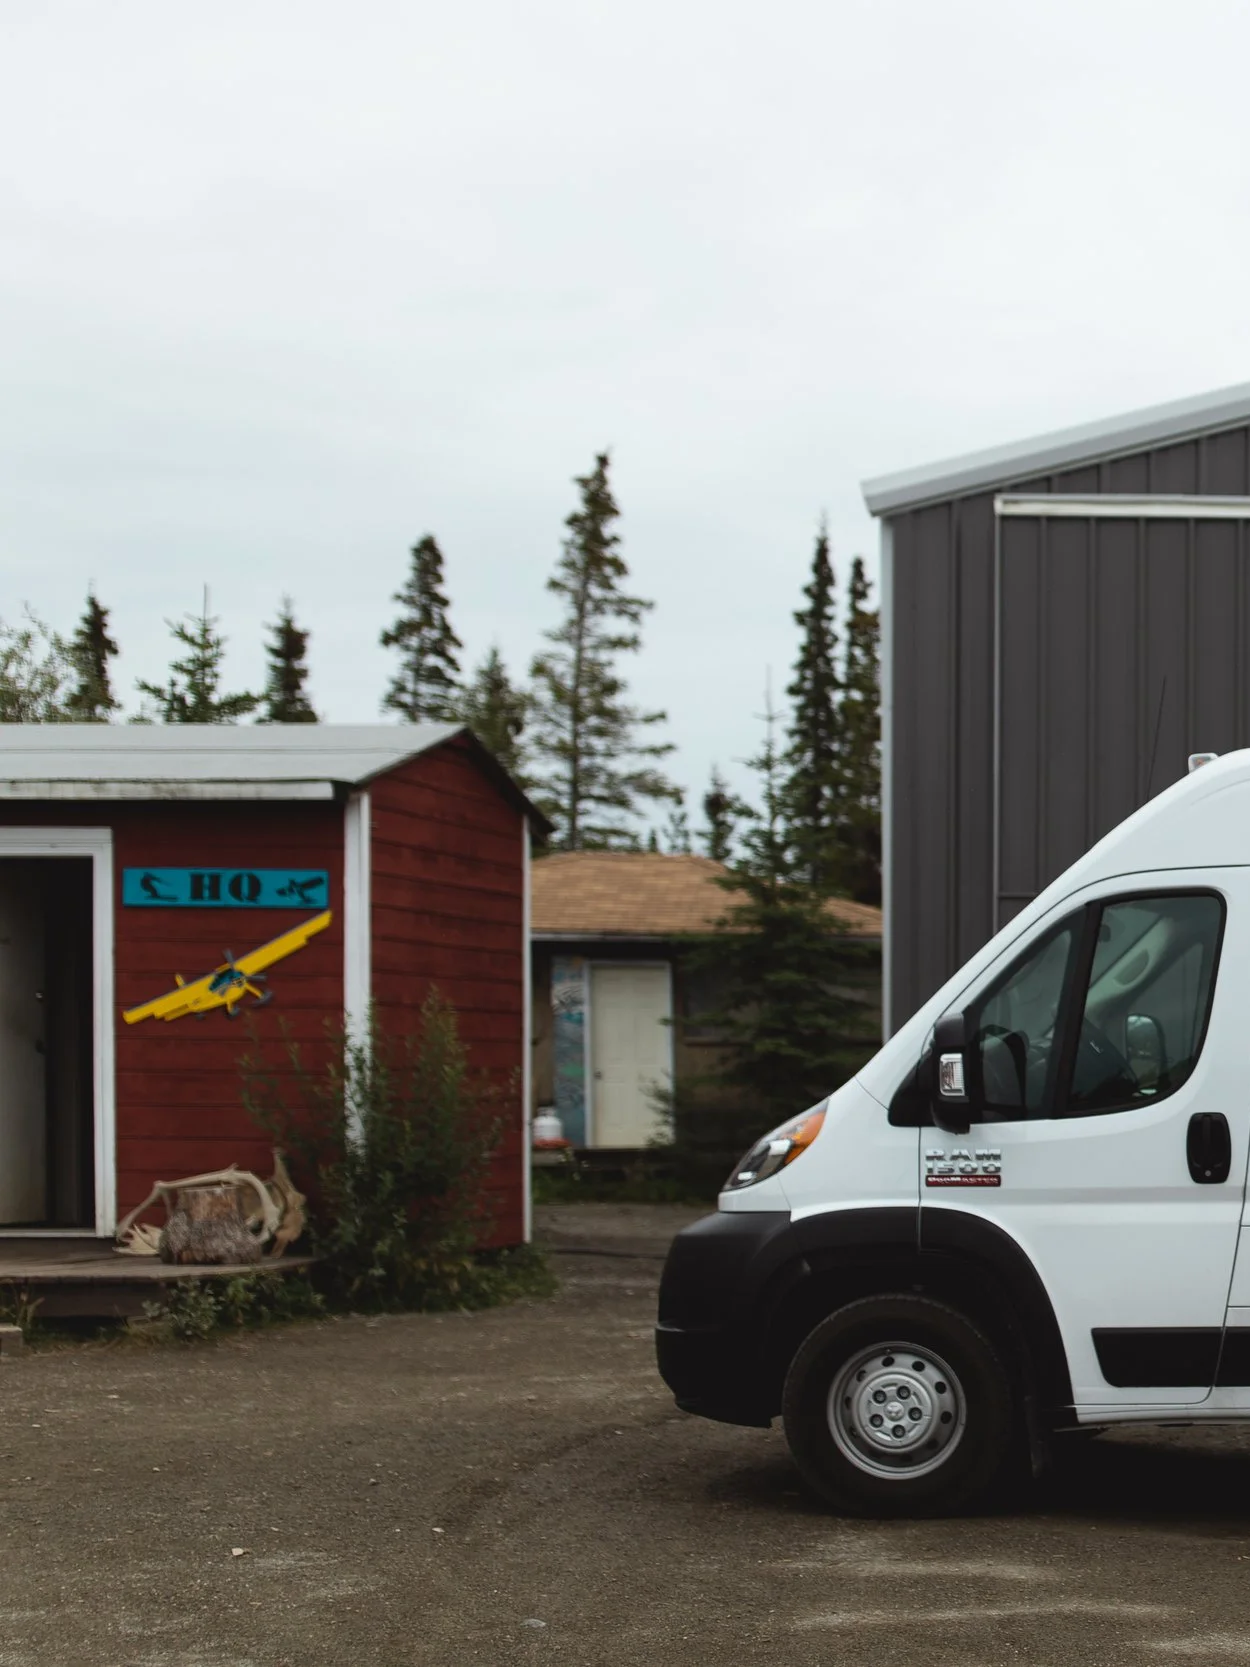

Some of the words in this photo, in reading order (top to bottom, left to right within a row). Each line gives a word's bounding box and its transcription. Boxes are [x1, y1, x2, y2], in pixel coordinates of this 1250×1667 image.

[189, 872, 262, 903] HQ
[925, 1148, 1001, 1161] RAM
[925, 1161, 1001, 1174] 1500
